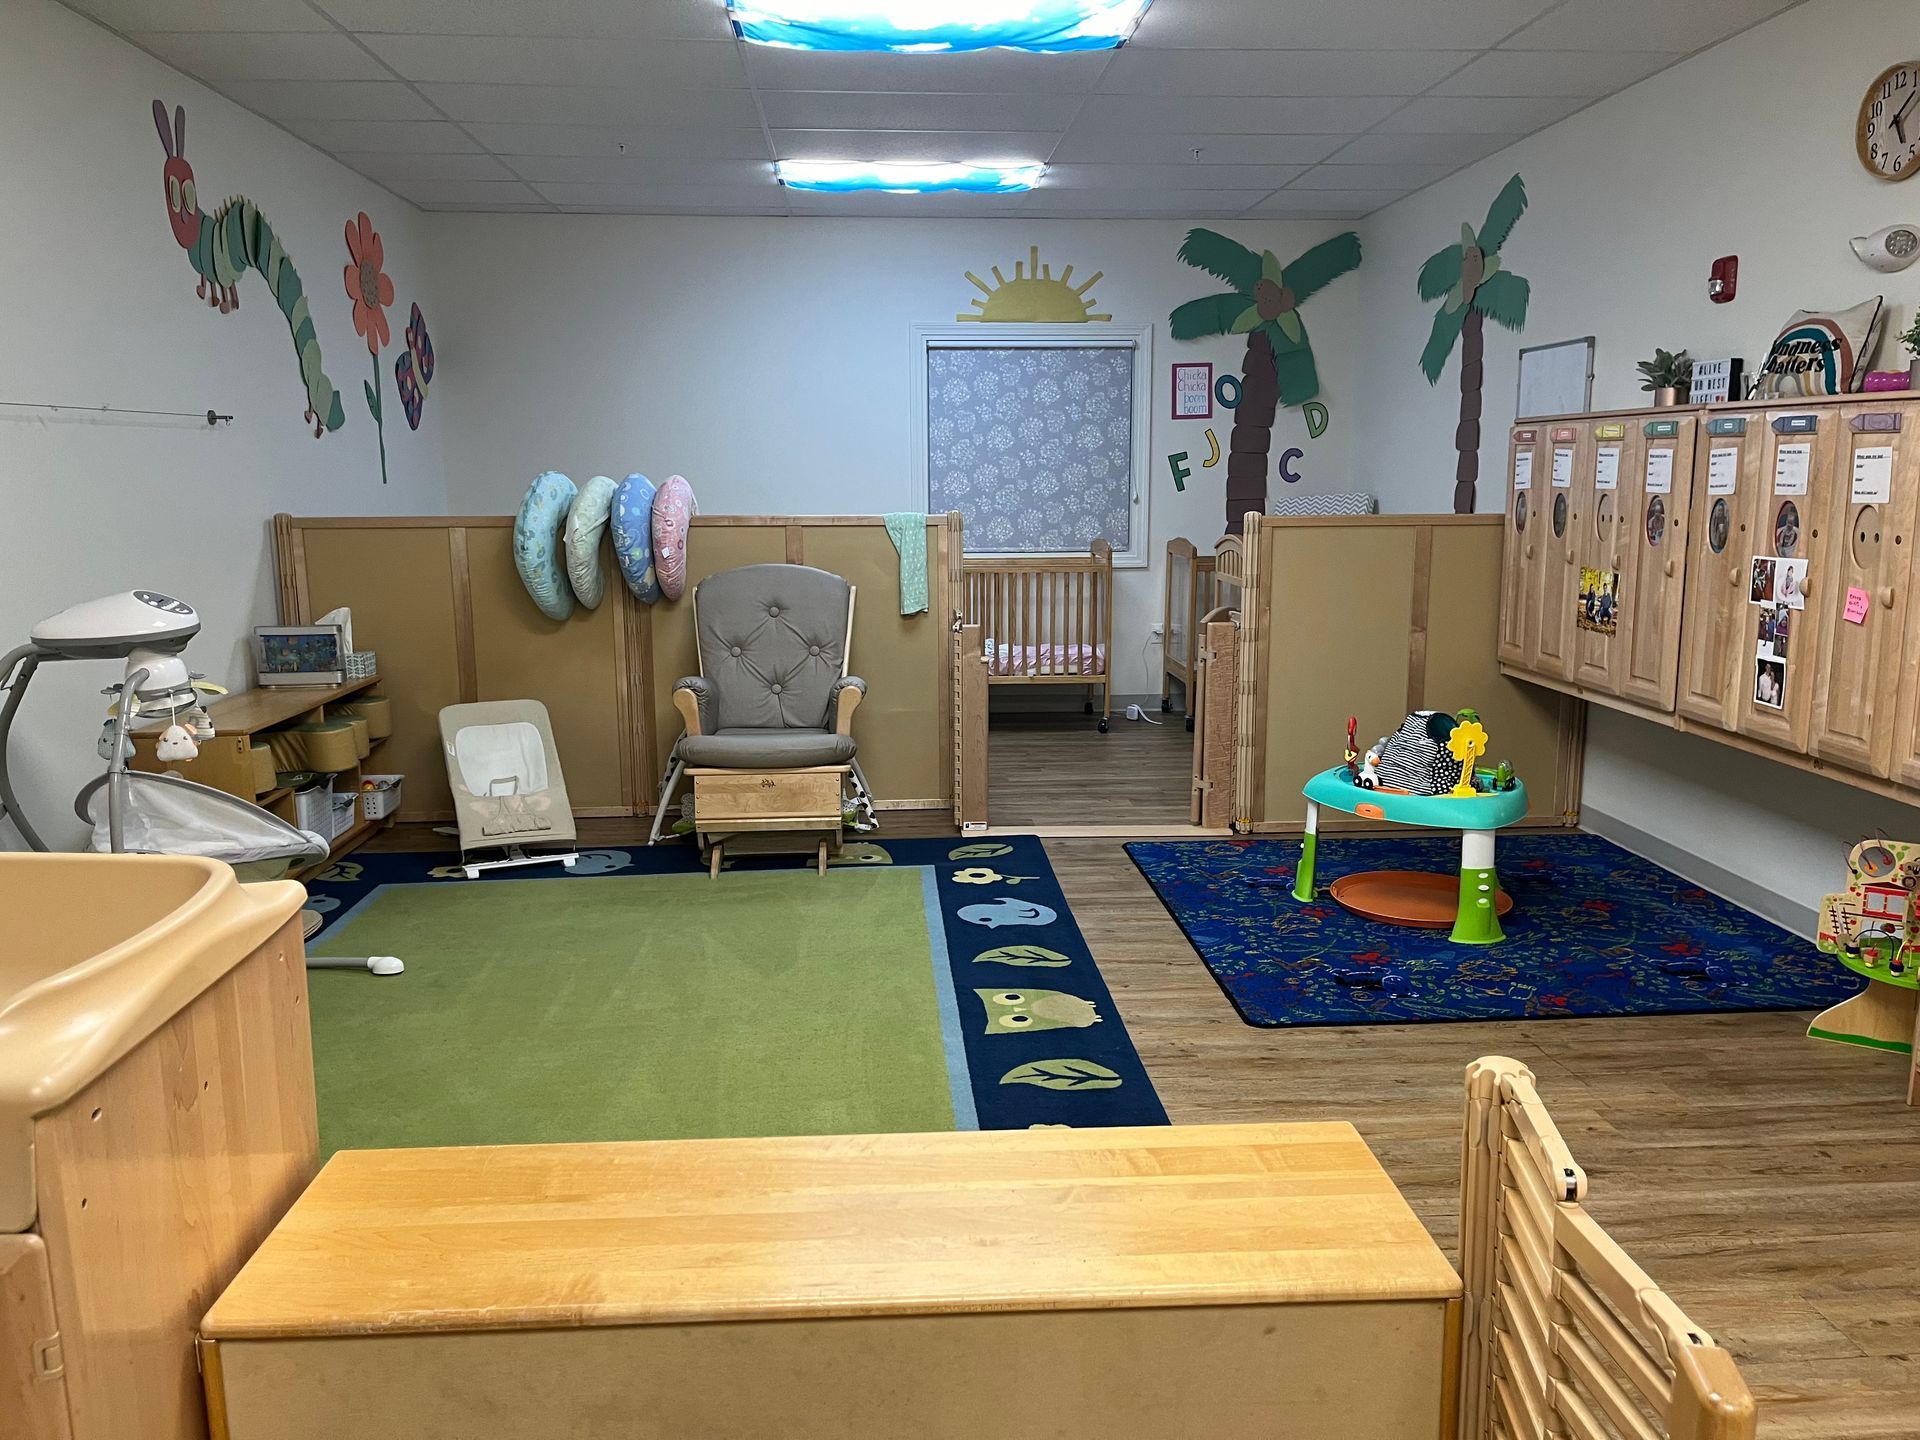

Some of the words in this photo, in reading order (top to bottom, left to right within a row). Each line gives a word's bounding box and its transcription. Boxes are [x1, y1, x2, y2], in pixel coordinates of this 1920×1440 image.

[1894, 71, 1907, 90] 12
[1913, 70, 1917, 87] 1
[1882, 81, 1891, 100] 11
[1871, 100, 1882, 120] 10
[1867, 122, 1875, 140] 9
[1870, 143, 1877, 160] 8
[1908, 144, 1915, 161] 5
[1881, 152, 1888, 170] 7
[1893, 155, 1901, 172] 6
[1178, 369, 1207, 380] Chicka
[1707, 377, 1725, 390] BEST
[1178, 380, 1206, 391] Chicka
[1214, 374, 1243, 409] O
[1302, 402, 1329, 439] D
[1202, 428, 1221, 468] J
[1167, 451, 1191, 492] F
[1279, 447, 1304, 483] C
